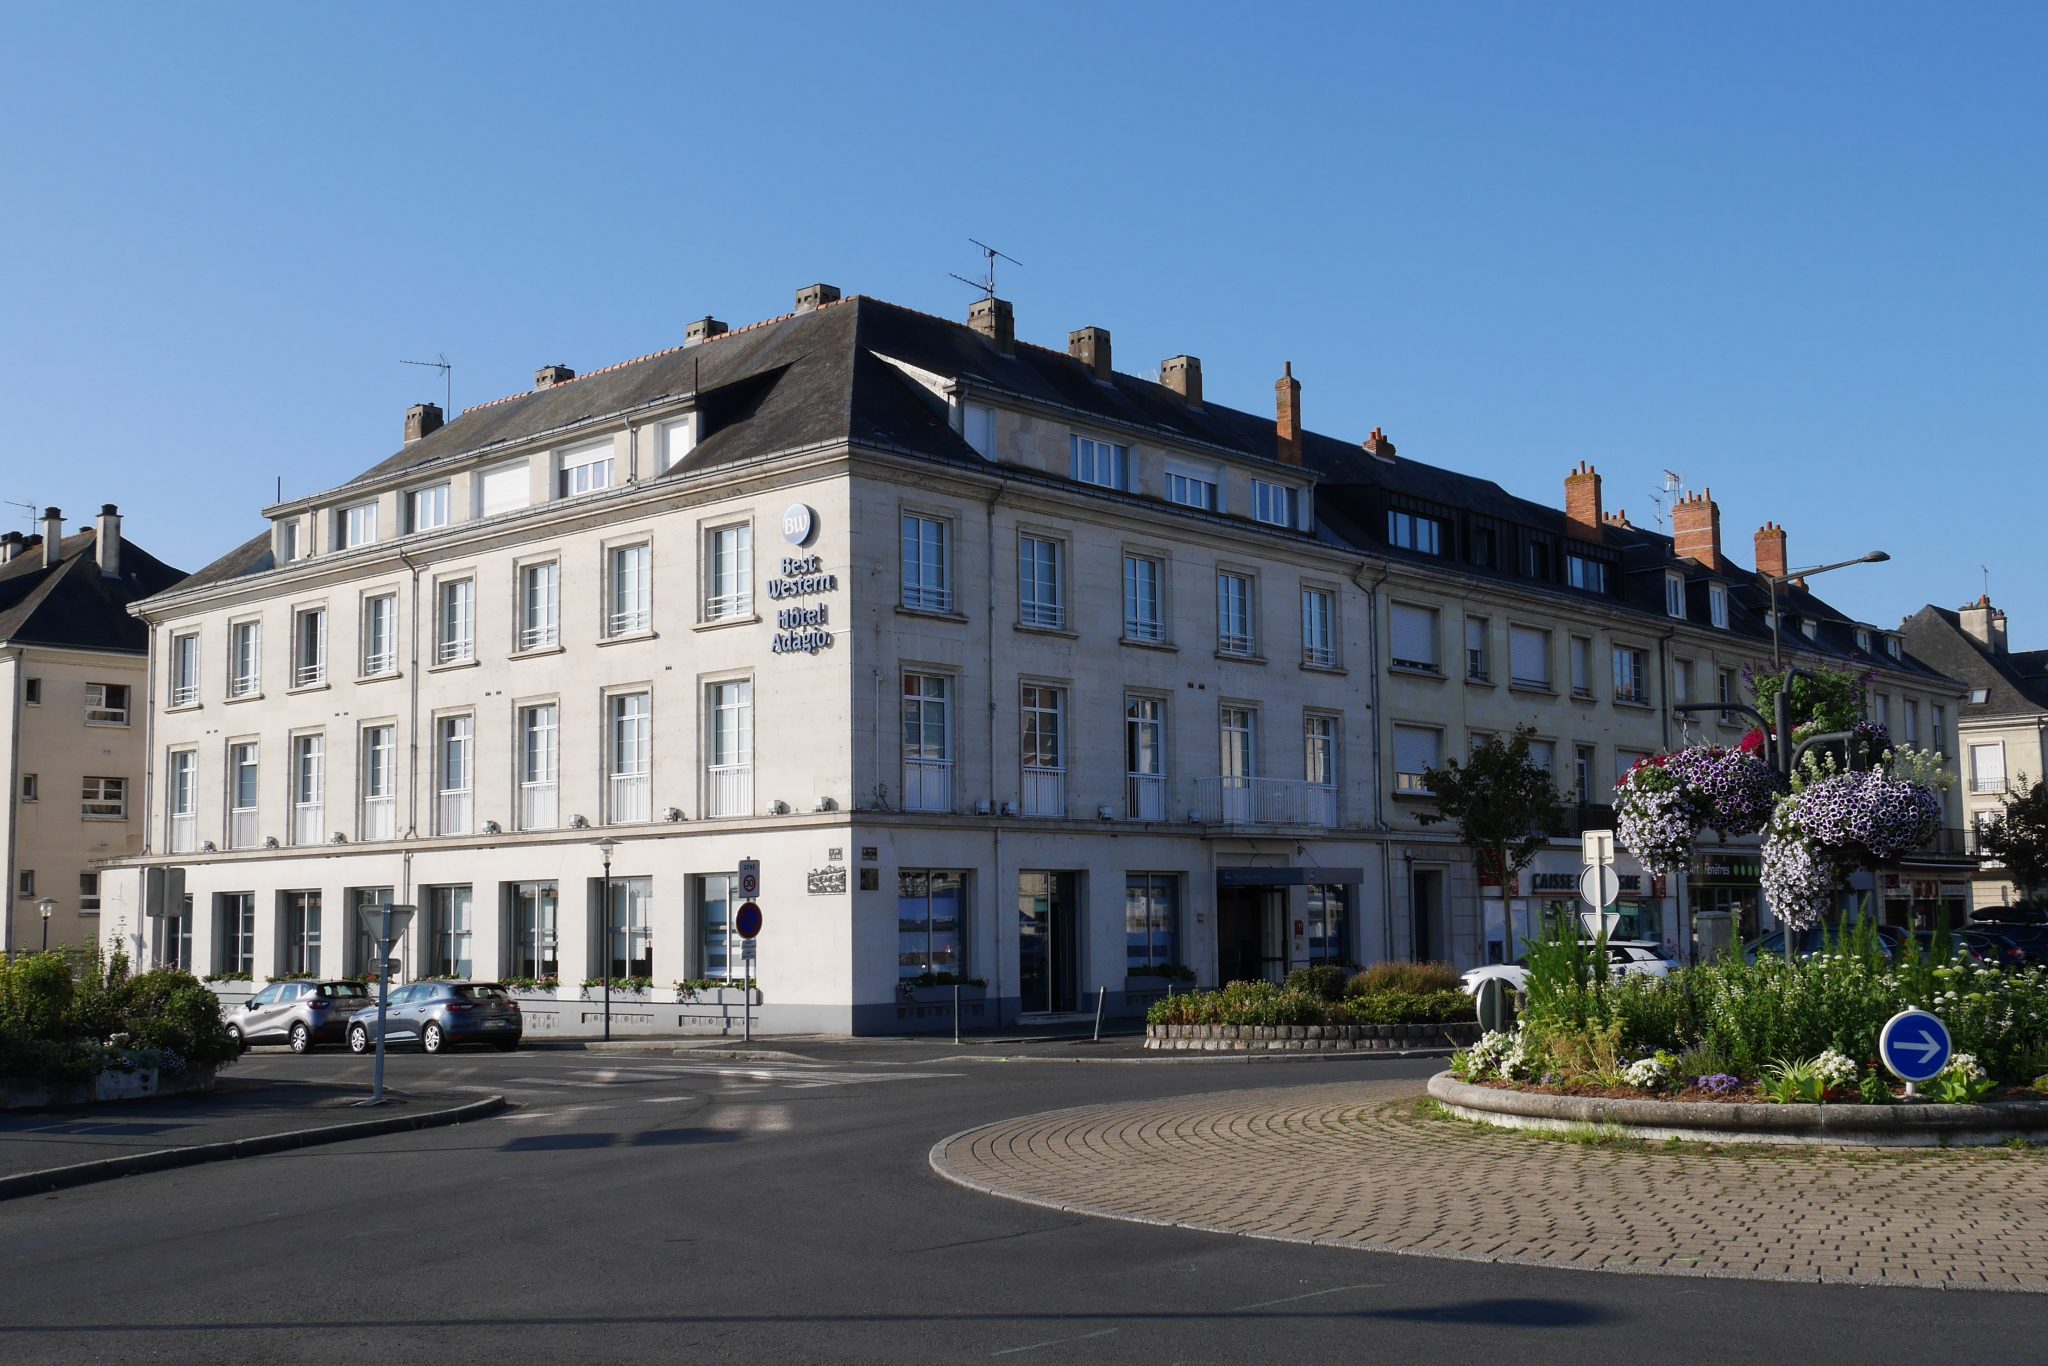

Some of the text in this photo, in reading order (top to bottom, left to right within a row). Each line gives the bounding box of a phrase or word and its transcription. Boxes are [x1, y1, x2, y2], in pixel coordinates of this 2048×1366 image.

[784, 514, 808, 535] BW
[781, 555, 818, 576] Best
[767, 574, 833, 598] Western
[777, 603, 827, 629] Hôtel
[771, 628, 829, 653] Adagio
[744, 878, 754, 888] 30
[1532, 873, 1574, 890] CAISSE
